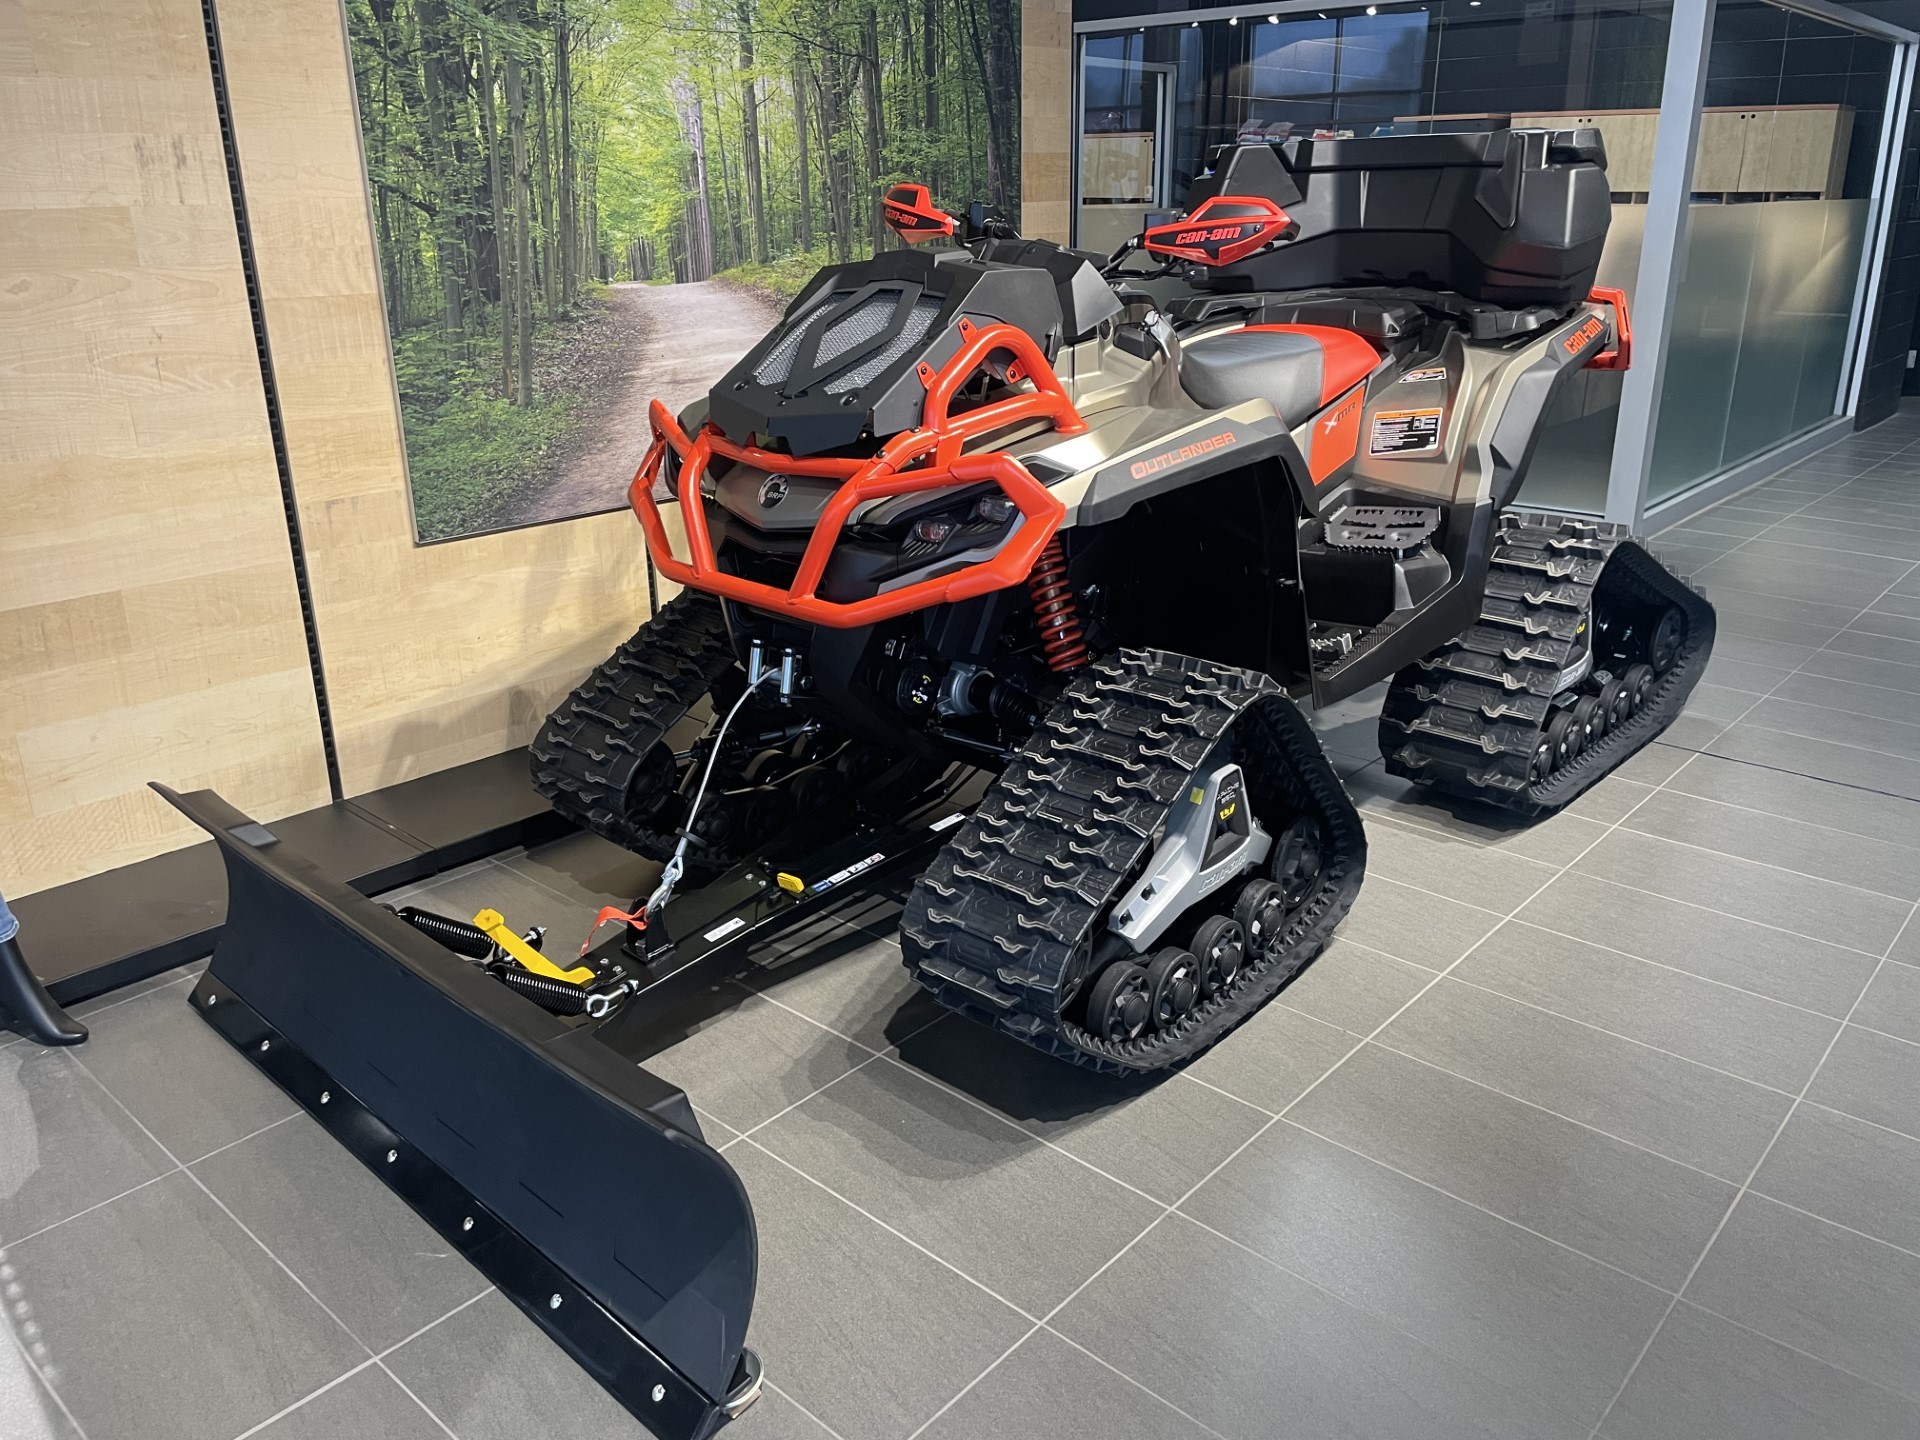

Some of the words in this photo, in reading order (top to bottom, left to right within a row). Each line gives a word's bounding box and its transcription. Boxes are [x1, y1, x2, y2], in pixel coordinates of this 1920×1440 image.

[885, 208, 918, 227] can-am
[1175, 226, 1242, 245] can-am
[1563, 317, 1604, 355] can-am
[1130, 431, 1237, 480] OUTLANDER
[766, 491, 784, 500] BRP
